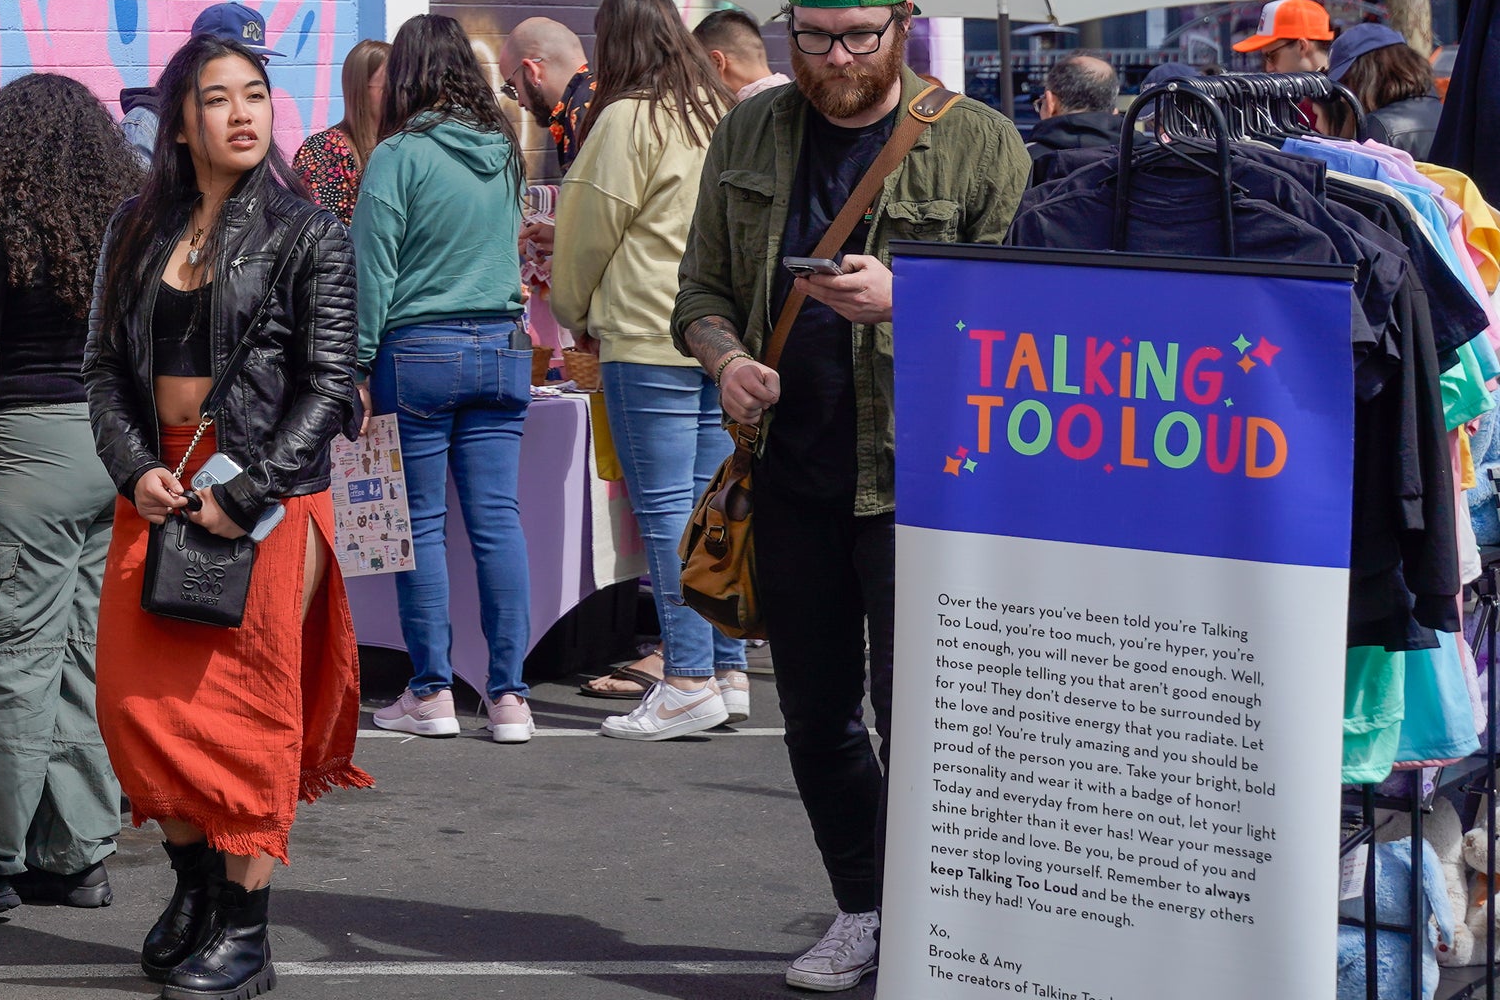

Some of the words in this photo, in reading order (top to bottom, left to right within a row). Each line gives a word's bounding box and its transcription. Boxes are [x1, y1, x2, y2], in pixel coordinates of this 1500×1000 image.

[967, 395, 1104, 460] TOO
[1119, 406, 1288, 478] LOUD
[937, 613, 961, 628] Too
[965, 616, 1002, 634] Loud,
[1005, 623, 1046, 638] you're
[1049, 626, 1072, 641] too
[1076, 631, 1115, 647] much,
[1119, 637, 1162, 651] you're
[1165, 639, 1208, 658] hyper,
[1212, 647, 1255, 662] you're
[938, 593, 972, 608] Over
[975, 596, 998, 611] the
[1001, 603, 1035, 616] years
[1039, 606, 1082, 621] you've
[1085, 608, 1119, 625] been
[1123, 614, 1150, 629] told
[1154, 619, 1197, 634] you're
[1201, 622, 1248, 643] Talking
[936, 636, 959, 649] not
[962, 640, 1014, 657] enough,
[1017, 647, 1041, 659] you
[1044, 647, 1067, 661] will
[1071, 654, 1109, 666] never
[1113, 654, 1130, 669] be
[1133, 660, 1168, 674] good
[1171, 666, 1227, 683] enough.
[1231, 668, 1264, 687] Well,
[936, 654, 973, 671] those
[977, 662, 1022, 678] people
[1025, 666, 1067, 686] telling
[1070, 675, 1094, 687] you
[1097, 674, 1125, 690] that
[1129, 682, 1168, 696] aren't
[1172, 686, 1207, 700] good
[1211, 692, 1262, 709] enough
[934, 696, 957, 711] the
[961, 698, 989, 714] love
[991, 704, 1015, 718] and
[1019, 710, 1071, 725] positive
[1074, 718, 1121, 735] energy
[1124, 720, 1152, 736] that
[1156, 728, 1180, 741] you
[1185, 730, 1238, 747] radiate.
[1242, 735, 1264, 751] Let
[935, 674, 955, 689] for
[958, 680, 987, 694] you!
[990, 681, 1023, 701] They
[1025, 686, 1060, 703] don't
[1063, 691, 1117, 710] deserve
[1121, 699, 1136, 713] to
[1139, 700, 1157, 715] be
[1160, 708, 1241, 726] surrounded
[1245, 713, 1261, 732] by
[933, 740, 974, 754] proud
[977, 743, 992, 756] of
[994, 745, 1016, 760] the
[1019, 753, 1065, 767] person
[1069, 759, 1093, 772] you
[1096, 763, 1122, 775] are.
[1126, 763, 1157, 780] Take
[1160, 772, 1192, 785] your
[1196, 772, 1241, 793] bright,
[1245, 779, 1275, 796] bold
[934, 716, 969, 733] them
[972, 723, 992, 738] go!
[996, 723, 1037, 742] You're
[1040, 731, 1072, 750] truly
[1075, 739, 1130, 758] amazing
[1133, 745, 1159, 759] and
[1162, 751, 1187, 763] you
[1191, 750, 1237, 769] should
[1241, 756, 1259, 772] be
[932, 778, 972, 798] Today
[975, 786, 999, 800] and
[1003, 792, 1063, 812] everyday
[1066, 797, 1098, 814] from
[1102, 802, 1133, 819] here
[1137, 812, 1154, 823] on
[1158, 814, 1185, 828] out,
[1189, 814, 1208, 830] let
[1211, 822, 1243, 835] your
[1247, 823, 1276, 842] light
[933, 762, 1007, 783] personality
[1010, 770, 1034, 784] and
[1037, 776, 1071, 789] wear
[1074, 778, 1083, 791] it
[1087, 781, 1116, 795] with
[1119, 788, 1127, 797] a
[1131, 784, 1173, 806] badge
[1176, 792, 1192, 806] of
[1195, 794, 1240, 813] honor!
[931, 821, 960, 836] with
[964, 826, 998, 841] pride
[1001, 832, 1026, 846] and
[1029, 833, 1060, 851] love.
[1064, 839, 1082, 854] Be
[1085, 847, 1113, 861] you,
[1117, 847, 1135, 863] be
[1138, 855, 1179, 870] proud
[1183, 858, 1198, 872] of
[1202, 865, 1227, 877] you
[1231, 867, 1256, 881] and
[932, 799, 968, 816] shine
[971, 803, 1024, 824] brighter
[1026, 812, 1056, 830] than
[1060, 818, 1070, 832] it
[1073, 824, 1103, 836] ever
[1107, 824, 1134, 841] has!
[1138, 829, 1174, 847] Wear
[1177, 839, 1210, 852] your
[1213, 845, 1272, 864] message
[930, 860, 964, 881] keep
[967, 866, 1013, 889] Talking
[1016, 874, 1040, 890] Too
[1044, 879, 1078, 896] Loud
[1081, 887, 1107, 901] and
[1110, 889, 1128, 904] be
[1131, 893, 1154, 908] the
[1158, 901, 1206, 920] energy
[1210, 907, 1254, 925] others
[931, 845, 969, 857] never
[972, 847, 1001, 865] stop
[1004, 850, 1043, 873] loving
[1046, 862, 1103, 879] yourself.
[1107, 867, 1182, 891] Remember
[1186, 880, 1201, 894] to
[1204, 883, 1251, 904] always
[929, 923, 950, 939] Xo,
[930, 884, 959, 898] wish
[963, 886, 992, 906] they
[995, 891, 1023, 908] had!
[1027, 897, 1052, 913] You
[1055, 906, 1077, 918] are
[1080, 910, 1134, 928] enough.
[928, 964, 954, 980] The
[957, 973, 1011, 991] creators
[1014, 980, 1028, 994] of
[929, 944, 976, 963] Brooke
[979, 952, 990, 966] &
[993, 956, 1022, 975] Amy
